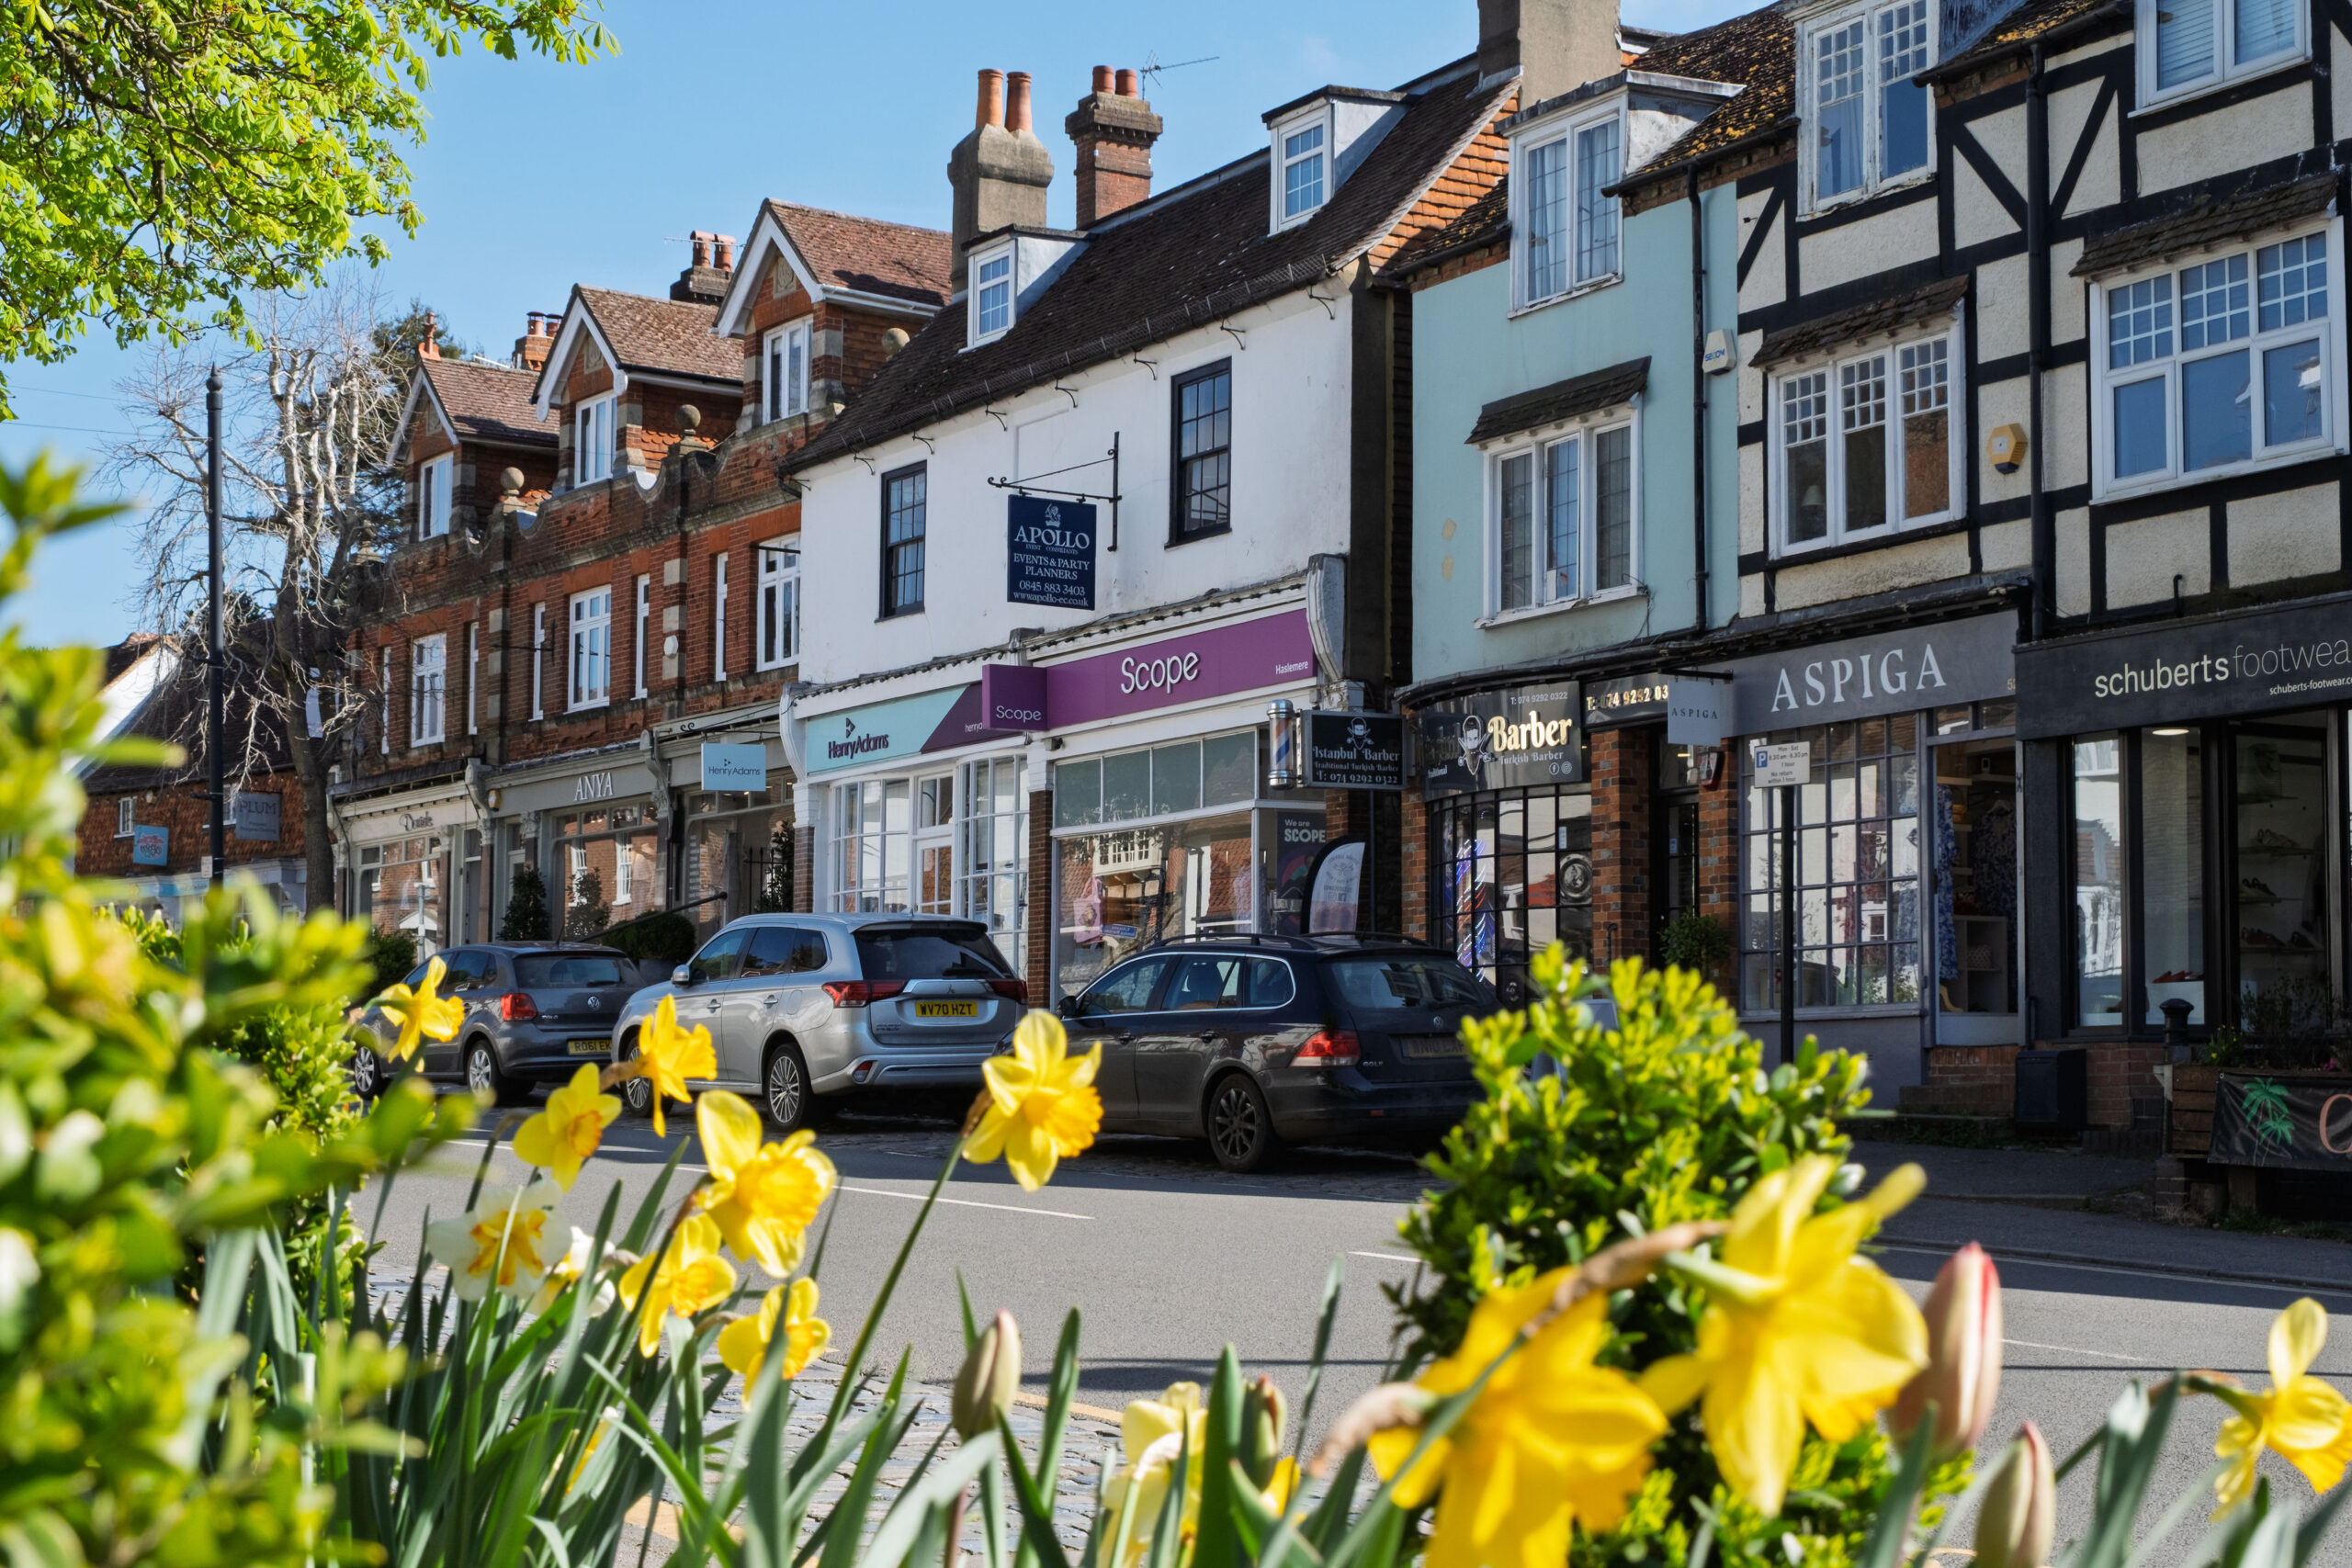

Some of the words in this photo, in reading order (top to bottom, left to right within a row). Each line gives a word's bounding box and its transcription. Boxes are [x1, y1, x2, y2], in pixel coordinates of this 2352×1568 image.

[1014, 525, 1091, 549] APOLLO
[1013, 553, 1049, 566] EVENTS
[1057, 558, 1091, 570] PARTY
[1025, 565, 1078, 580] PLANNERS
[1019, 580, 1041, 592] 0845
[1044, 582, 1061, 593] 883
[1062, 584, 1085, 596] 3403
[1121, 651, 1199, 694] Scope
[1275, 660, 1308, 674] Haslemere
[1770, 643, 1947, 712] ASPIGA
[1532, 694, 1549, 703] 9292
[1550, 691, 1568, 701] 0322
[996, 705, 1042, 723] Scope
[1671, 707, 1718, 719] ASPIGA
[1487, 710, 1573, 752] Barber
[1312, 746, 1357, 761] Istanbul
[1362, 748, 1401, 761] Barber
[1498, 752, 1529, 766] Turkish
[1532, 750, 1564, 762] Barber
[1314, 761, 1350, 771] Traditional
[1351, 762, 1375, 773] Turkish
[1376, 763, 1399, 773] Barber
[1329, 773, 1347, 784] 074
[1350, 773, 1373, 784] 9292
[1375, 774, 1397, 784] 0322
[572, 772, 614, 802] ANYA
[240, 800, 276, 815] PLUM
[1284, 829, 1326, 843] SCOPE
[920, 1003, 949, 1015] WV70
[951, 1003, 973, 1015] HZT
